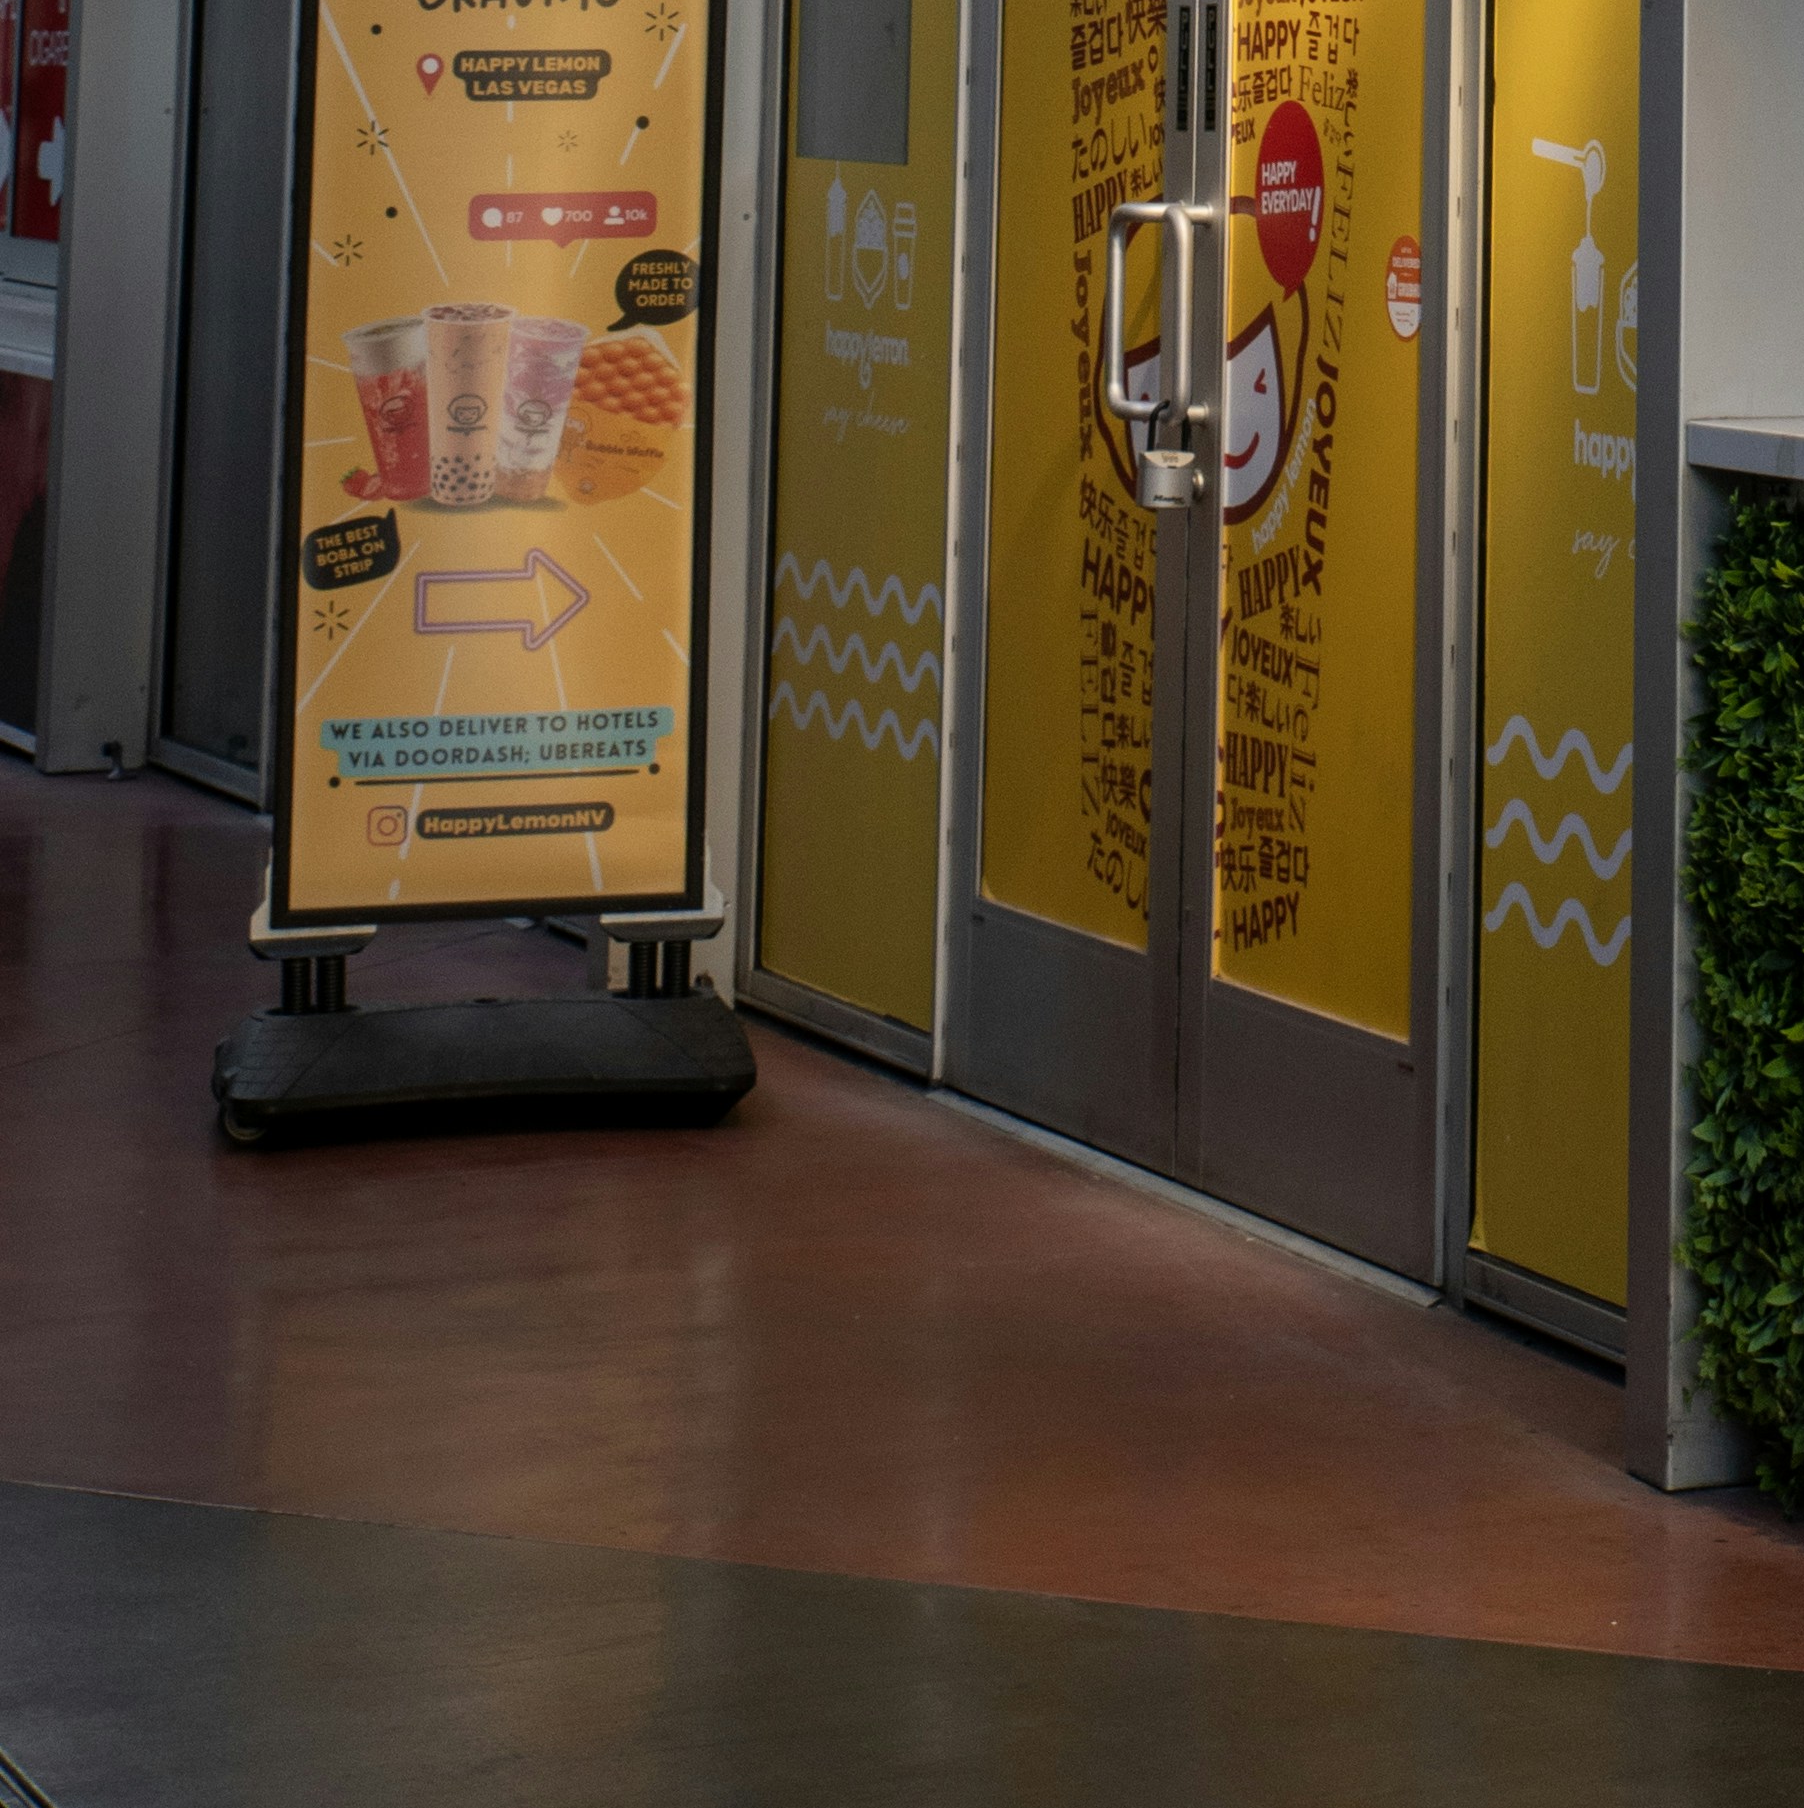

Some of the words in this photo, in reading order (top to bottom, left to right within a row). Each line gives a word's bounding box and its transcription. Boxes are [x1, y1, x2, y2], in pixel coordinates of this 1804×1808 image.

[1070, 12, 1125, 72] 즐겁다
[1237, 18, 1301, 63] HAPPY
[460, 57, 528, 72] HAPPY
[533, 57, 600, 72] LEMON
[472, 81, 513, 95] LAS
[518, 81, 586, 95] VEGAS
[1297, 64, 1347, 113] Feliz
[1071, 112, 1147, 184] たのしい
[1261, 160, 1297, 186] HAPPY
[564, 211, 592, 222] 700
[632, 263, 690, 275] FRESHLY
[628, 279, 668, 291] MADE
[672, 278, 693, 289] TO
[636, 295, 685, 307] ORDER
[1301, 354, 1339, 597] JOYEUX
[316, 534, 343, 550] THE
[346, 526, 378, 544] BEST
[316, 548, 357, 567] BOBA
[362, 541, 385, 555] ON
[334, 559, 373, 579] STRIP
[1237, 543, 1301, 622] HAPPY
[1230, 624, 1294, 690] JOYEUX
[331, 722, 361, 740] WE
[371, 720, 429, 740] ALSO
[440, 717, 527, 736] DELIVER
[537, 716, 567, 732] TO
[577, 711, 658, 730] HOTELS
[349, 750, 385, 768] VIA
[540, 740, 647, 760] UBEREATS
[1225, 730, 1289, 799] HAPPY
[423, 809, 607, 836] HappyLemonNV
[1231, 890, 1301, 953] HAPPY
